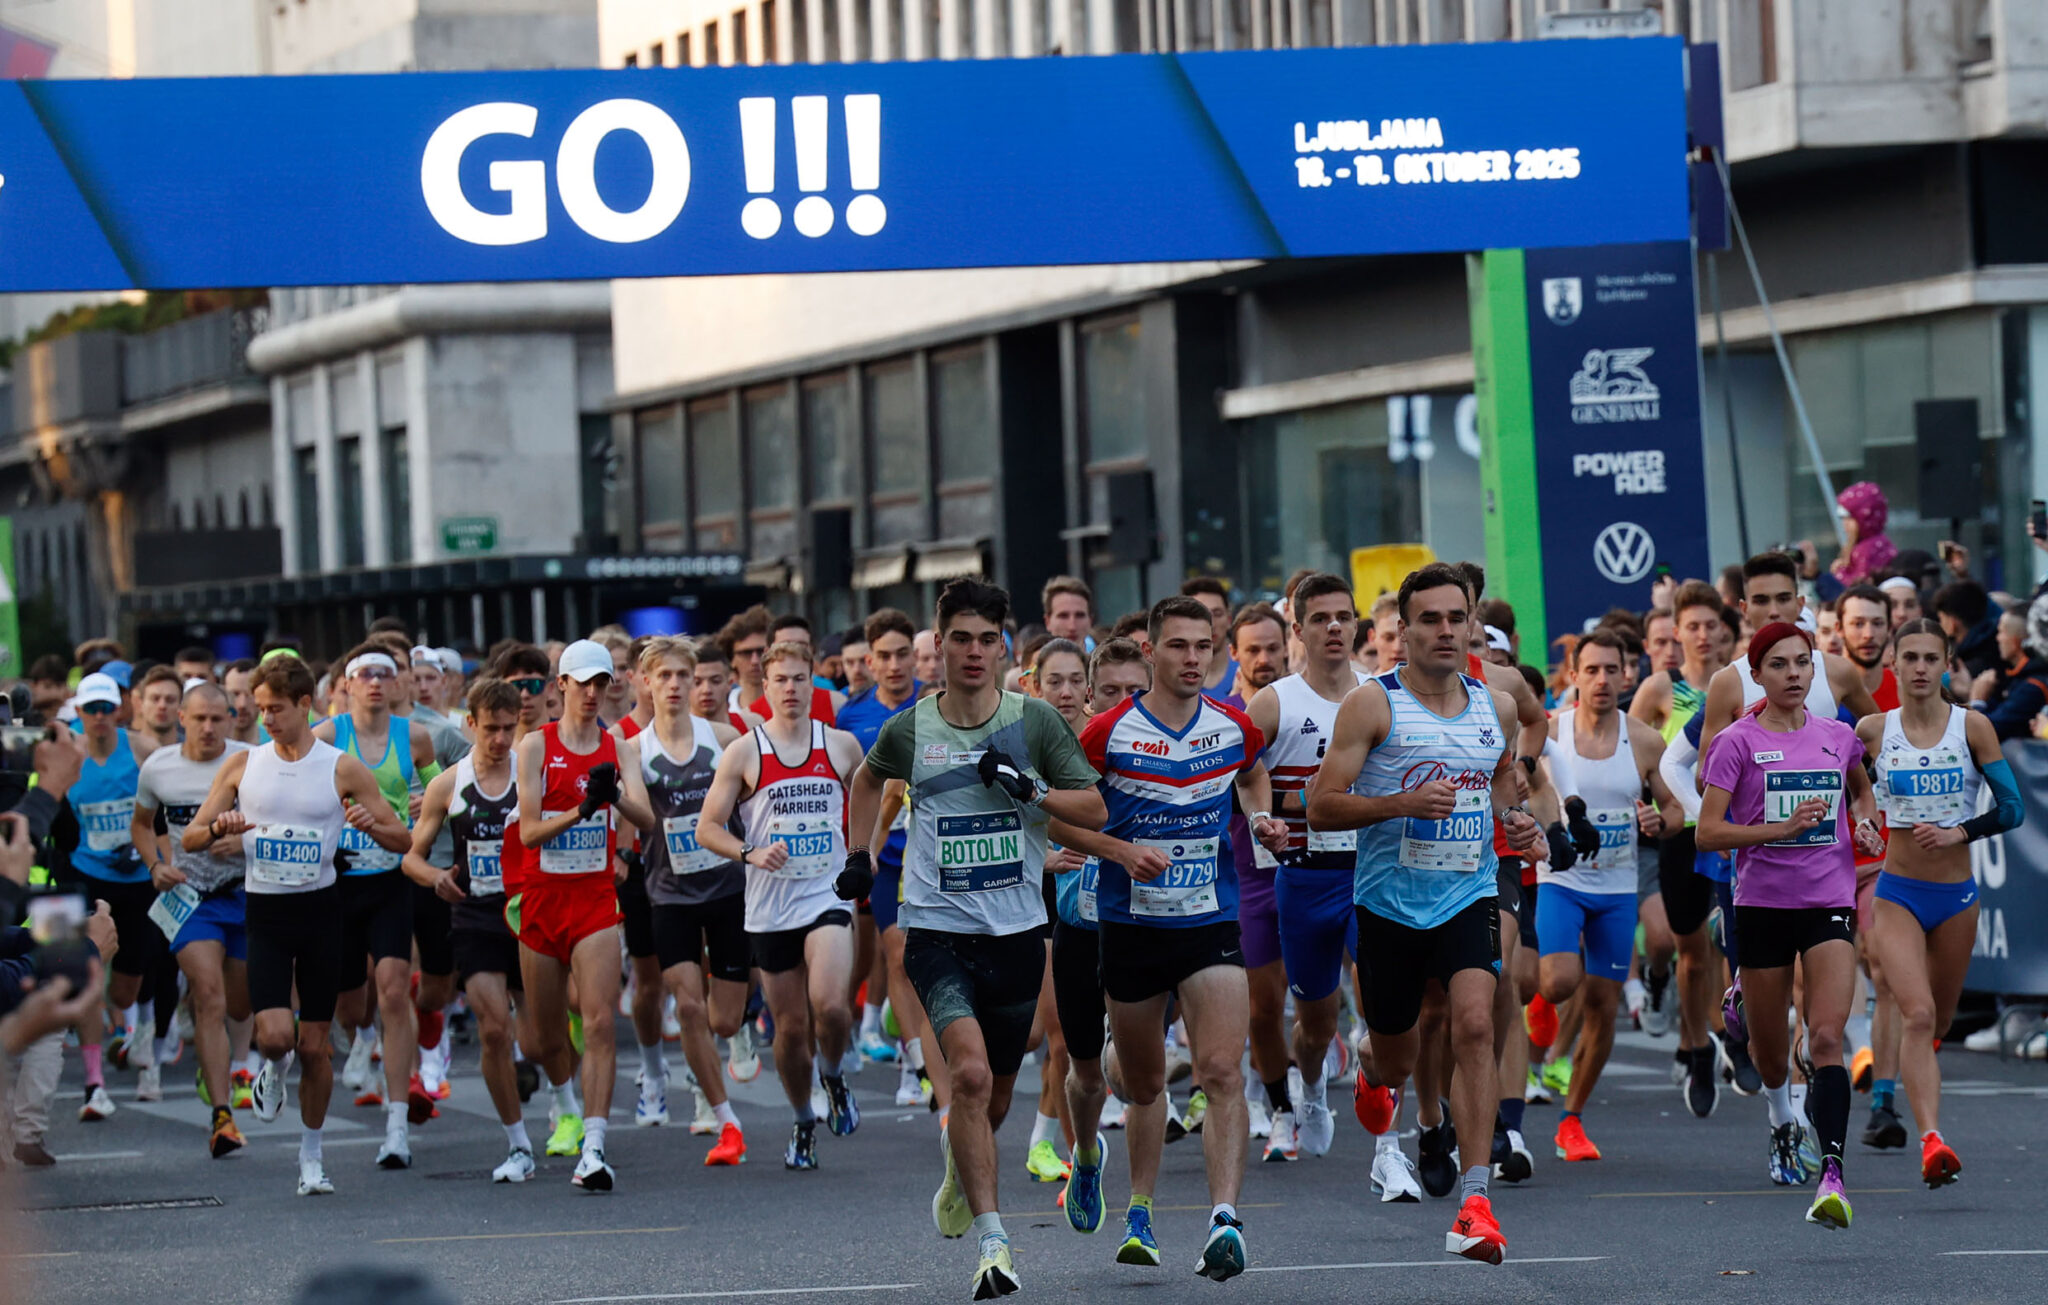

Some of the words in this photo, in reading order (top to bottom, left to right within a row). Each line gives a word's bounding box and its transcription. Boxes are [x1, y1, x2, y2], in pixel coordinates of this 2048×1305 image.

[1294, 117, 1444, 152] LJUBLJANA
[421, 98, 691, 245] GO
[739, 93, 887, 240] !!!
[1394, 150, 1511, 184] OKTOBER
[1514, 147, 1580, 180] 2025
[1573, 450, 1665, 477] POWER
[1301, 725, 1319, 735] PEAK
[1201, 733, 1221, 749] IVT
[1189, 755, 1224, 772] BIOS
[768, 784, 833, 800] GATESHEAD
[1910, 772, 1960, 794] 19812
[774, 801, 828, 815] HARRIERS
[1434, 816, 1482, 840] 13003
[564, 829, 604, 848] 13800
[675, 835, 685, 852] A
[790, 835, 830, 855] 18575
[263, 841, 271, 858] B
[276, 842, 319, 862] 13400
[941, 834, 1018, 865] BOTOLIN
[983, 876, 1018, 888] GARMIN
[1164, 861, 1213, 886] 19729
